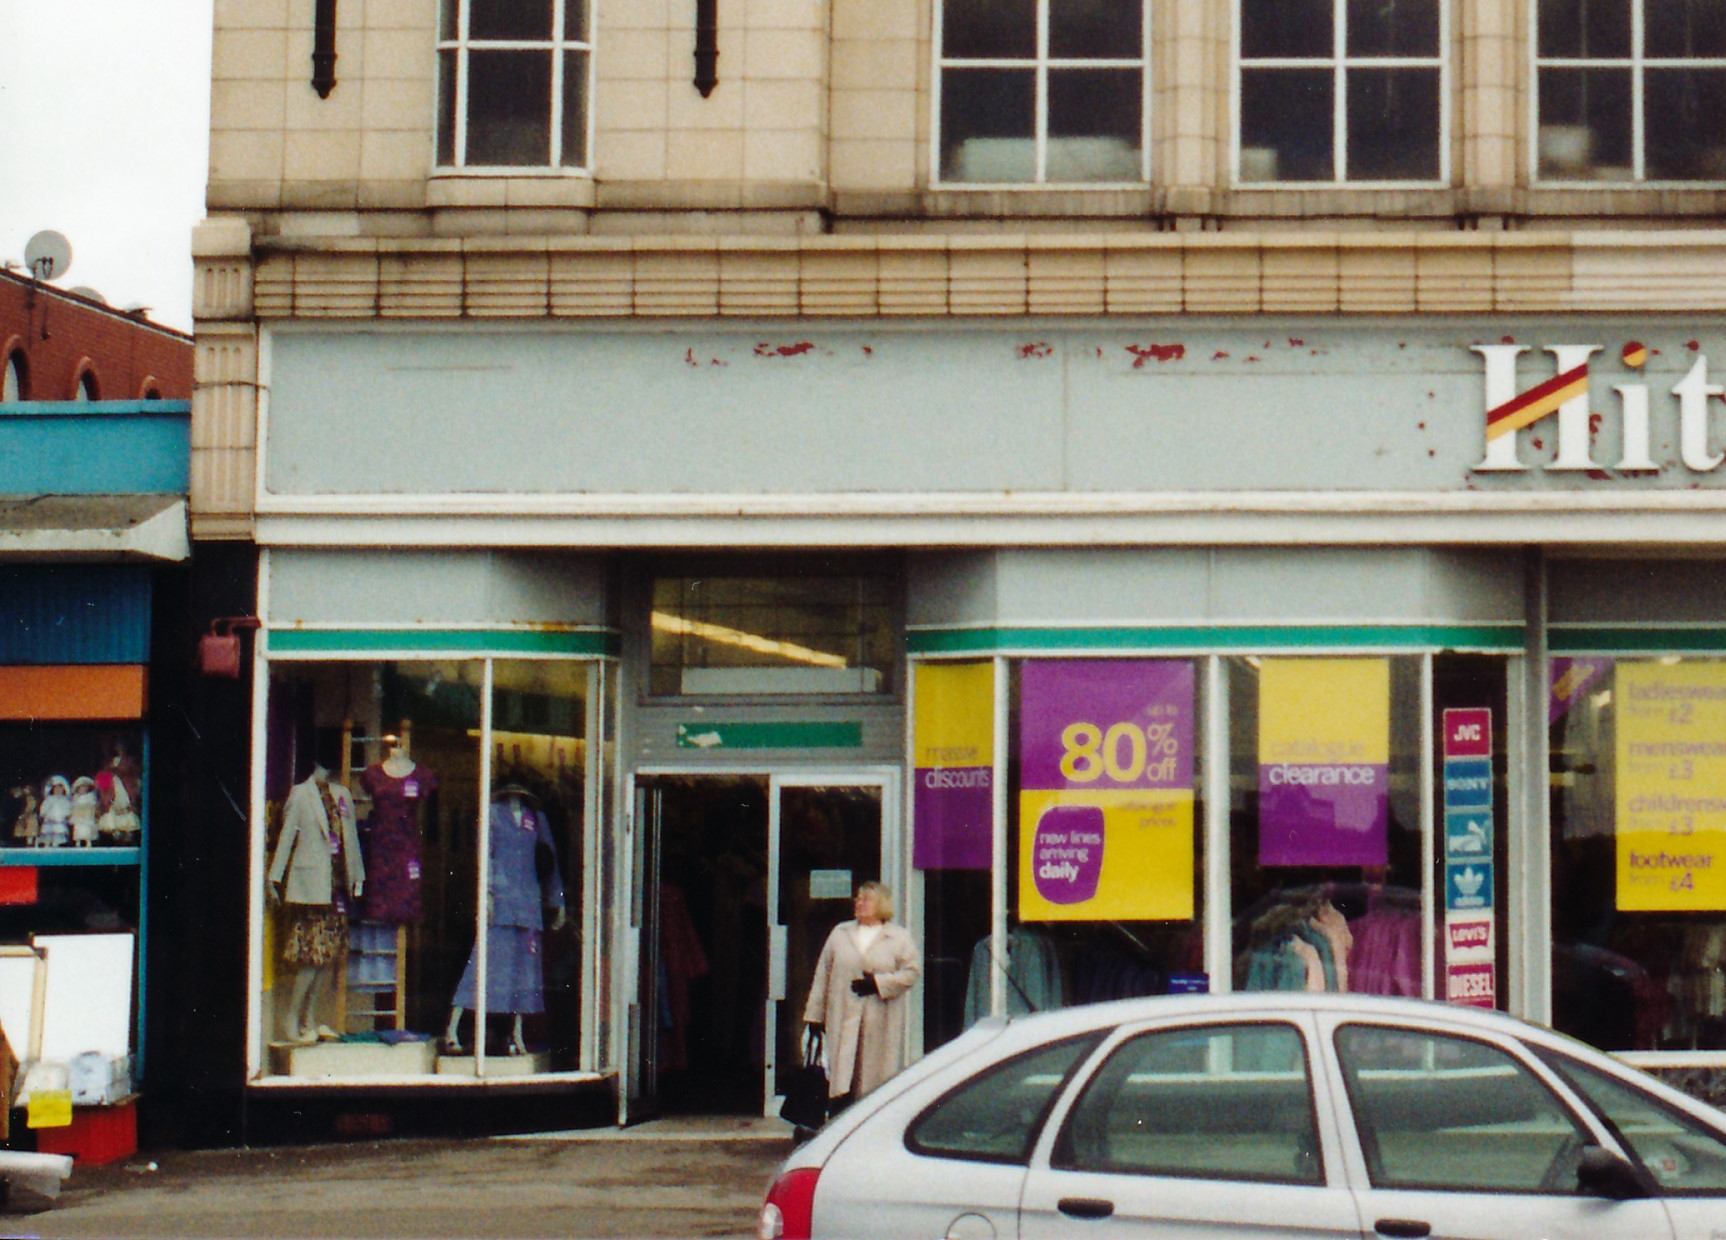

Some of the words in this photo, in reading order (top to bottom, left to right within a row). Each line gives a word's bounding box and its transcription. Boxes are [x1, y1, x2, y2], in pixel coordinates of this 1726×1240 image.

[1453, 724, 1481, 741] JVC
[925, 764, 990, 788] discounts
[1147, 757, 1177, 782] off
[1268, 760, 1376, 786] clearance
[1039, 833, 1067, 845] new
[1070, 830, 1101, 845] lines
[1039, 847, 1089, 864] arriving
[1629, 849, 1713, 869] footwear
[1039, 860, 1079, 883] daily
[1449, 972, 1494, 996] DIESEL
